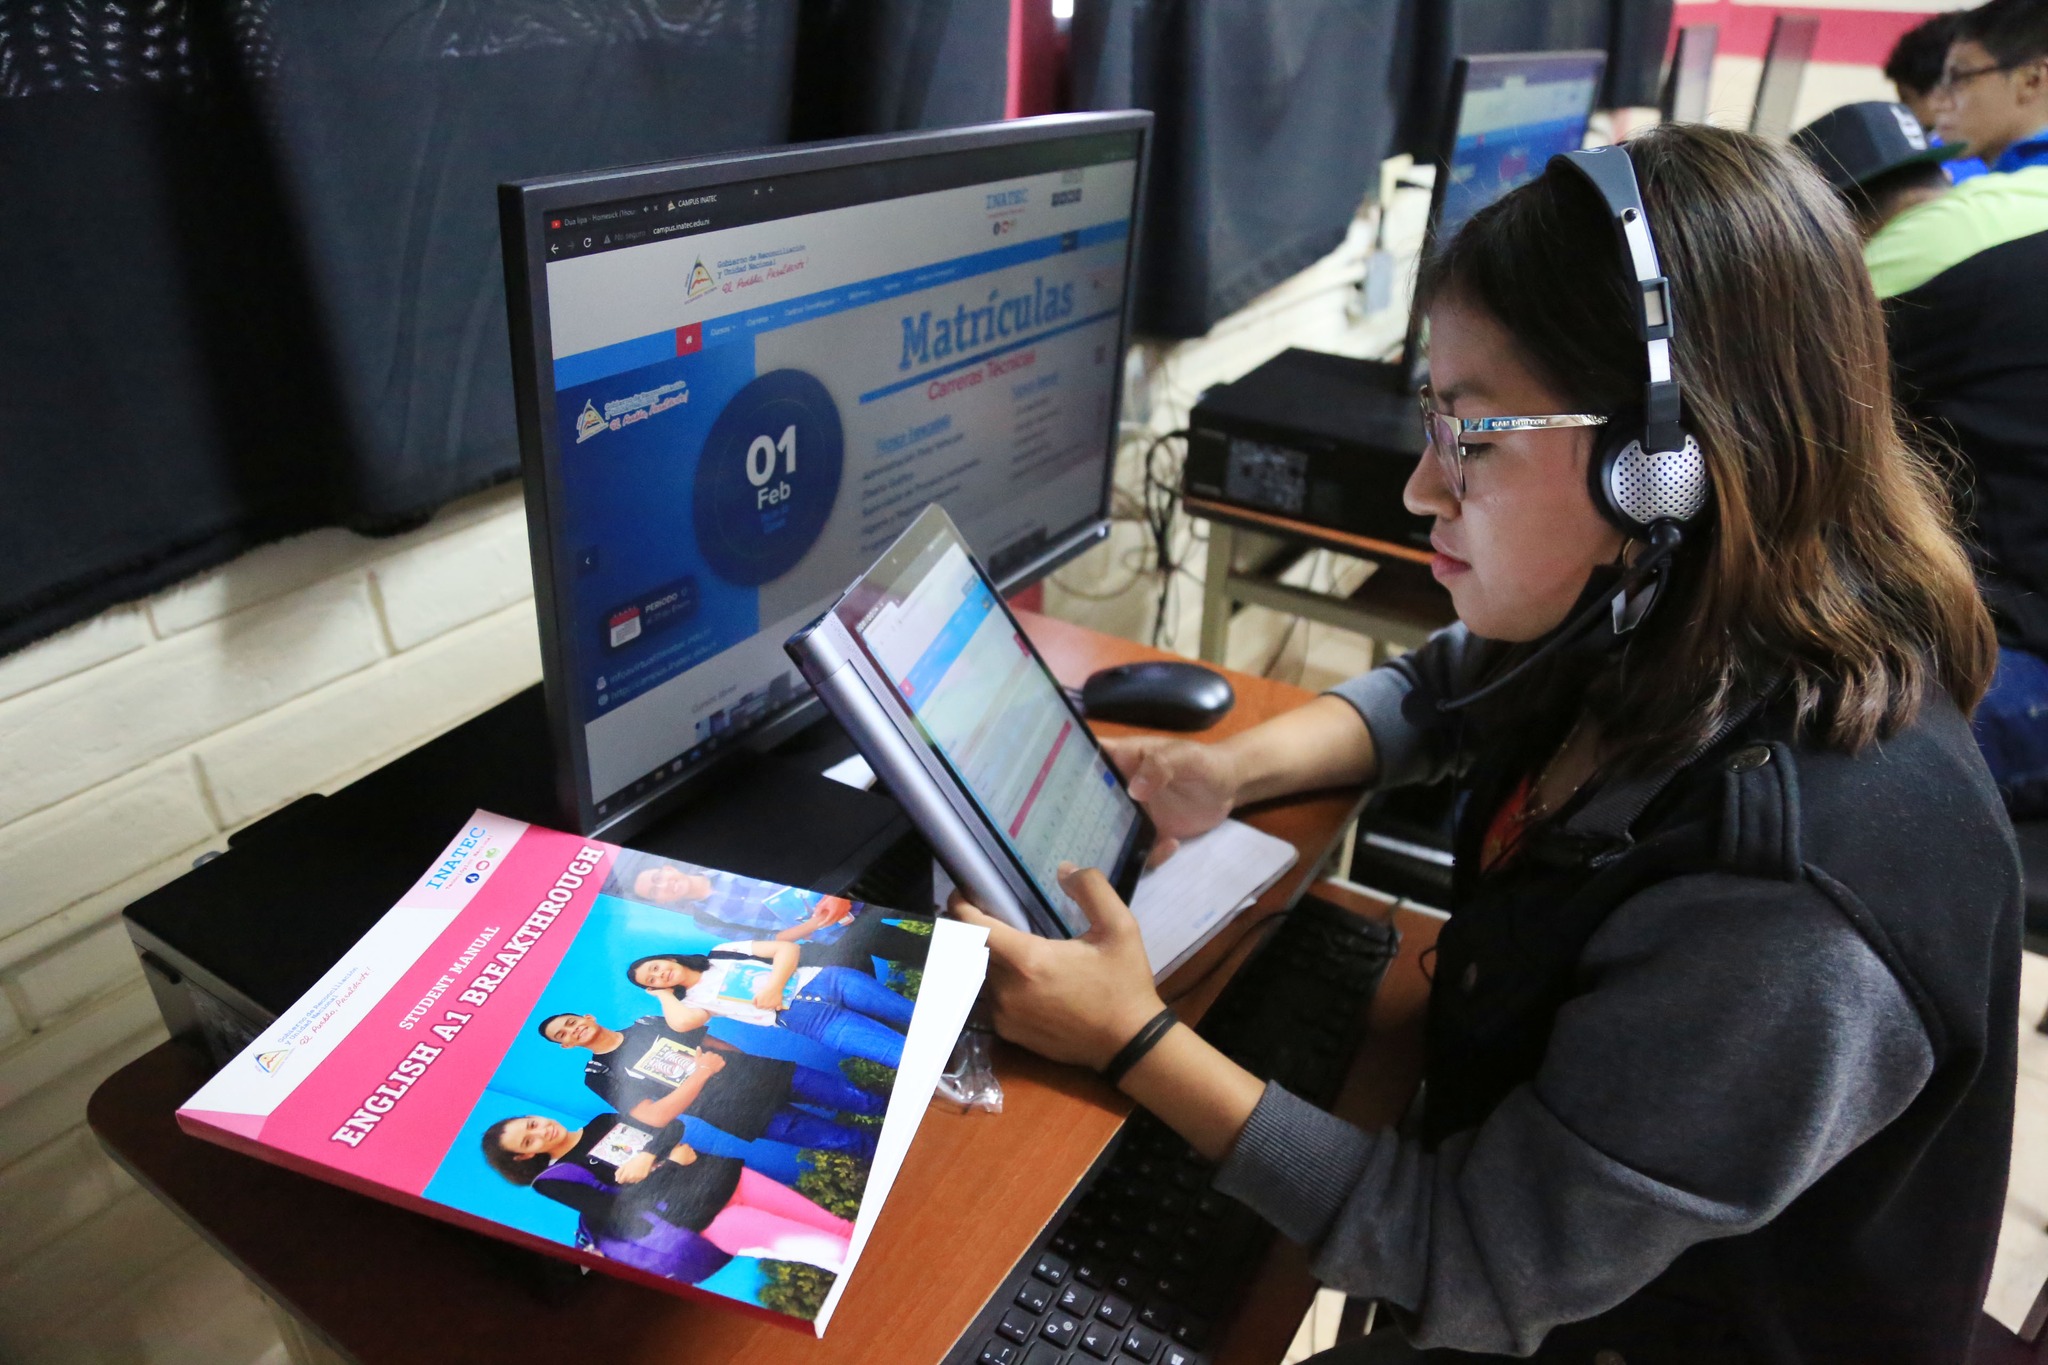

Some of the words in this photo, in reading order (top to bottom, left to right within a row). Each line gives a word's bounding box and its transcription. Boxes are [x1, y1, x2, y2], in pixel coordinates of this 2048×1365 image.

[678, 197, 699, 208] CAMPUS
[700, 194, 718, 204] INATEC
[564, 217, 577, 227] Dua
[593, 211, 618, 222] Homesick
[653, 218, 710, 235] campus.inatec.edu.ni
[717, 257, 748, 268] Gobierno
[898, 276, 1074, 371] Matrículas
[927, 369, 983, 400] Carreras
[746, 425, 796, 487] 01
[757, 481, 791, 510] Feb
[425, 827, 486, 890] INATEC
[399, 974, 455, 1031] STUDENT
[449, 925, 501, 975] MANUAL
[331, 1042, 443, 1149] ENGLISH
[431, 1010, 473, 1042] A1
[459, 845, 605, 1008] BREAKTHROUGH
[289, 1020, 313, 1040] Unidad
[311, 995, 338, 1020] Nacional
[278, 1017, 307, 1043] Gobierno
[299, 1035, 313, 1045] El
[1080, 1267, 1091, 1276] E
[1118, 1277, 1127, 1286] D
[1160, 1281, 1169, 1289] C
[1033, 1299, 1043, 1307] 2
[1063, 1291, 1076, 1303] W
[1102, 1305, 1112, 1315] S
[1144, 1309, 1155, 1318] X
[1047, 1324, 1058, 1333] Q
[1063, 1321, 1073, 1331] @
[1086, 1336, 1097, 1345] A
[1128, 1338, 1139, 1348] Z
